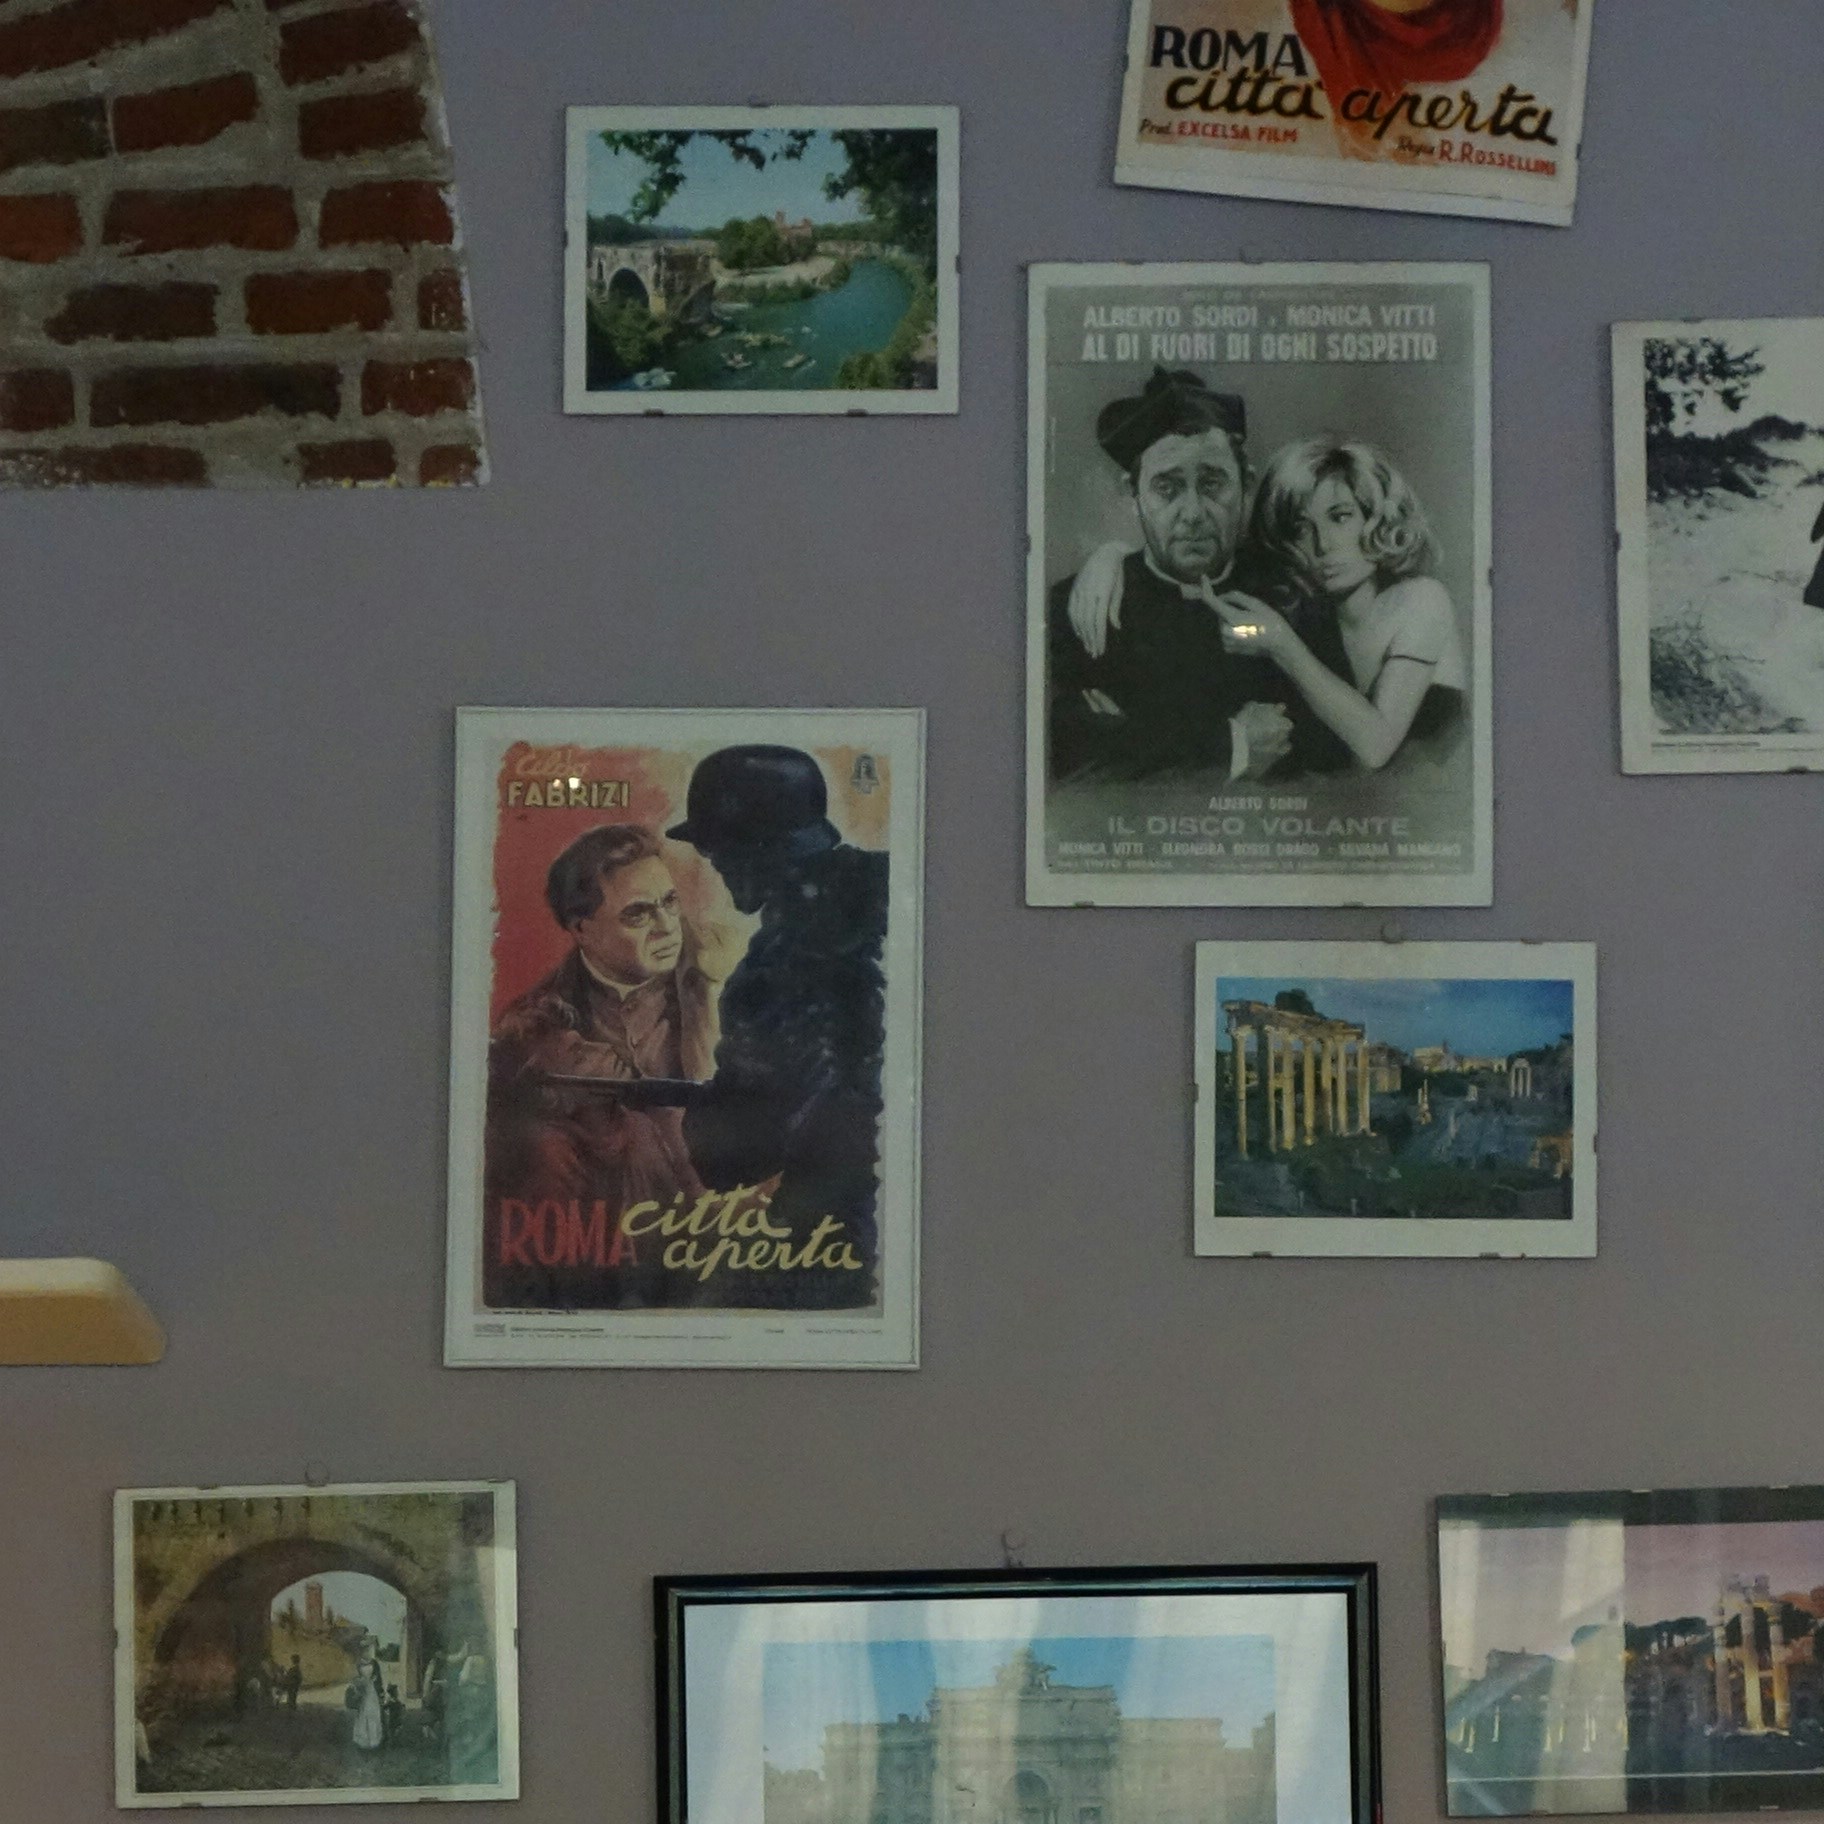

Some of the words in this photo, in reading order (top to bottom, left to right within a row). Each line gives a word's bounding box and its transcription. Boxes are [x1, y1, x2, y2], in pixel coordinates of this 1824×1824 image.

[1149, 24, 1308, 76] ROMA
[1341, 83, 1558, 146] aperta
[1083, 305, 1181, 327] ALBERTO
[1191, 305, 1259, 327] SORDI
[1286, 305, 1373, 327] MONICA
[1380, 305, 1436, 327] VITTI
[1081, 333, 1110, 362] AL
[1115, 333, 1140, 361] DI
[1150, 333, 1217, 362] FUORI
[1226, 333, 1251, 362] DI
[1260, 333, 1318, 362] OGNI
[1325, 333, 1438, 361] SOSPETTO
[507, 779, 631, 808] FABRIZI
[1107, 816, 1136, 836] IL
[1147, 815, 1246, 836] DISCO
[1262, 816, 1411, 836] VOLANTE
[499, 1198, 639, 1267] ROMA
[621, 1184, 793, 1238] città
[662, 1213, 864, 1283] aperta
